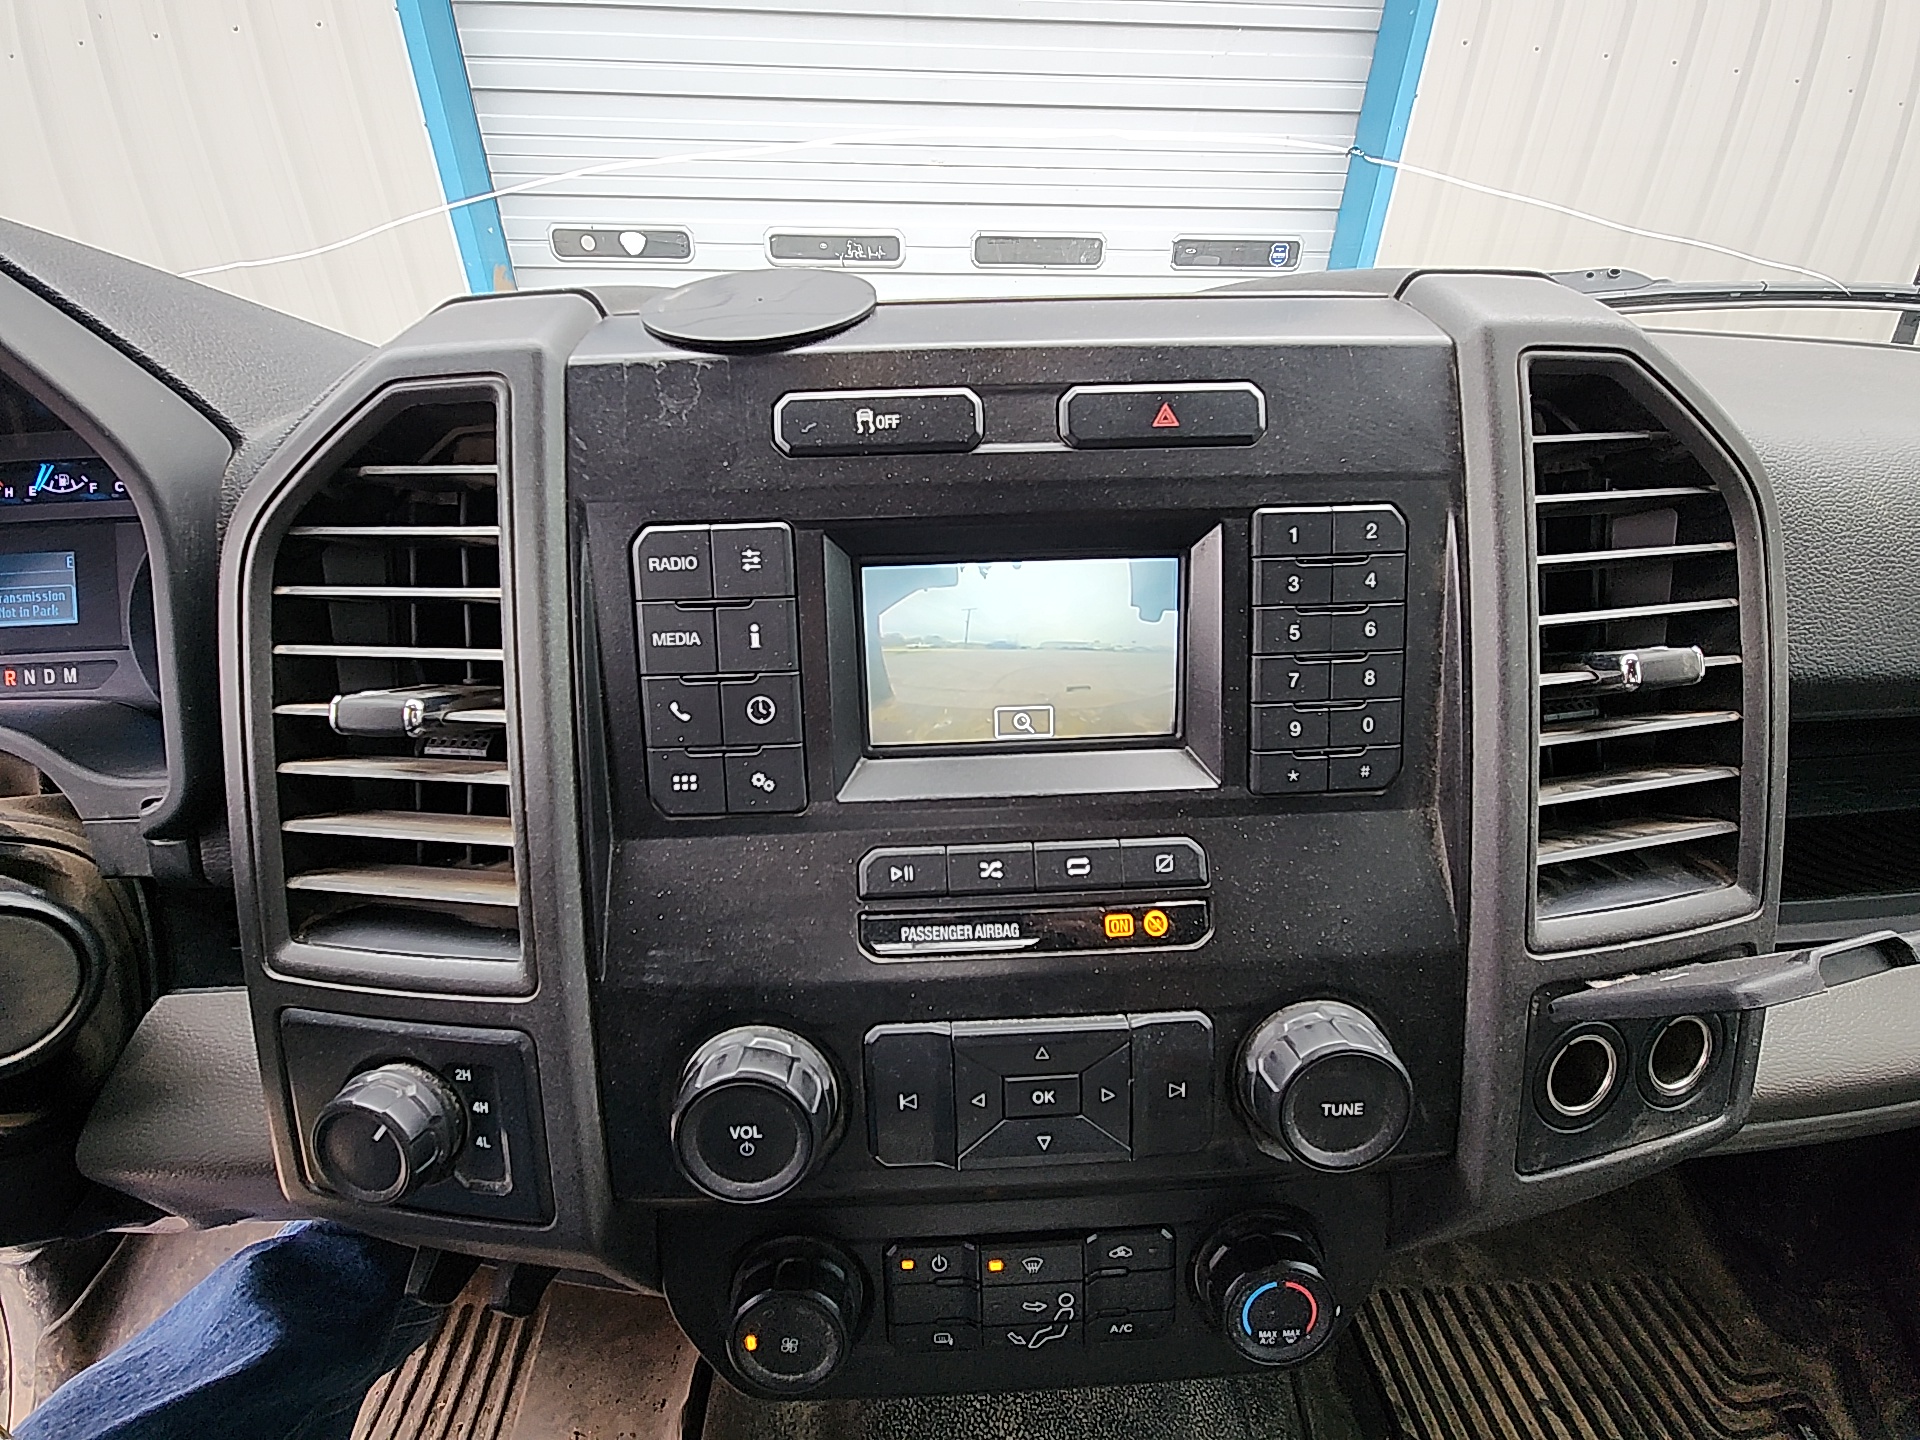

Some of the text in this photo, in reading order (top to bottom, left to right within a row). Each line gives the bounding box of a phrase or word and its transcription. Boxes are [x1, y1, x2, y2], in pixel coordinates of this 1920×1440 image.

[875, 414, 901, 430] OFF
[4, 486, 14, 498] H
[28, 485, 38, 497] E
[88, 482, 98, 494] F
[114, 481, 125, 493] C
[1290, 527, 1298, 543] 1
[1366, 522, 1378, 539] 2
[648, 555, 698, 572] RADIO
[1288, 575, 1300, 592] 3
[1364, 572, 1377, 588] 4
[19, 606, 30, 618] in
[32, 603, 59, 617] Park
[1289, 625, 1300, 641] 5
[1364, 621, 1377, 637] 6
[652, 631, 702, 647] MEDIA
[4, 667, 78, 686] R N D M
[1288, 672, 1300, 688] 7
[1364, 669, 1376, 686] 8
[1289, 721, 1302, 737] 9
[1362, 717, 1374, 733] 0
[900, 922, 1020, 942] PASSENGER AIRBAG
[1110, 919, 1129, 933] ON
[455, 1068, 472, 1082] 2H
[1032, 1090, 1056, 1104] OK
[472, 1101, 489, 1114] 4H
[1321, 1102, 1364, 1117] TUNE
[729, 1124, 763, 1140] VOL
[475, 1136, 492, 1149] 4L
[1109, 1323, 1133, 1334] A/C
[1258, 1330, 1278, 1338] MAX
[1282, 1328, 1301, 1338] MAX
[1259, 1337, 1276, 1345] A/C
